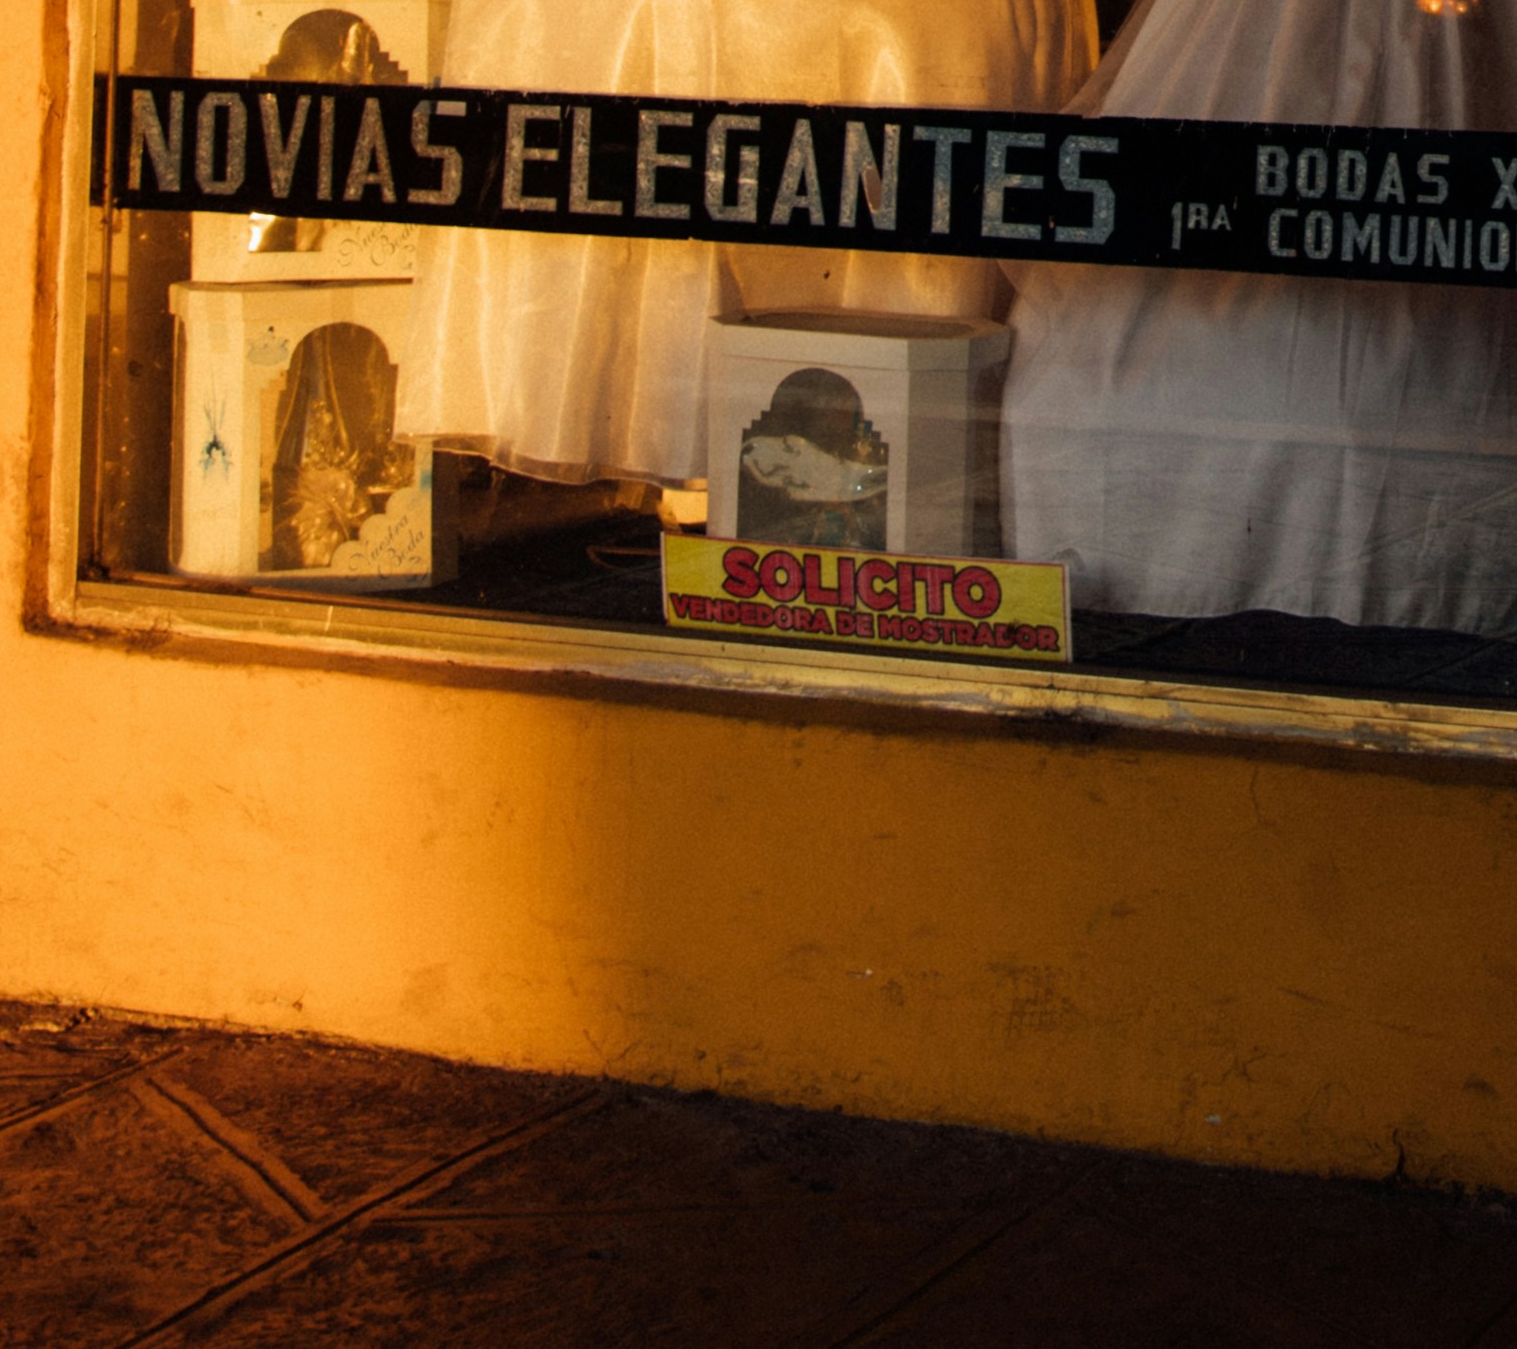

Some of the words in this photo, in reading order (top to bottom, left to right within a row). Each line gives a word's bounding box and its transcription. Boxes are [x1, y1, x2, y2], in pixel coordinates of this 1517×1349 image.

[125, 86, 469, 206] NOVIAS
[500, 103, 1121, 246] ELEGANTES
[1253, 143, 1452, 205] BODAS
[721, 546, 1002, 619] SOLICITO
[670, 593, 833, 634] VENDEDORA
[837, 610, 875, 639] DE
[877, 613, 1061, 652] MOSTRADOR
